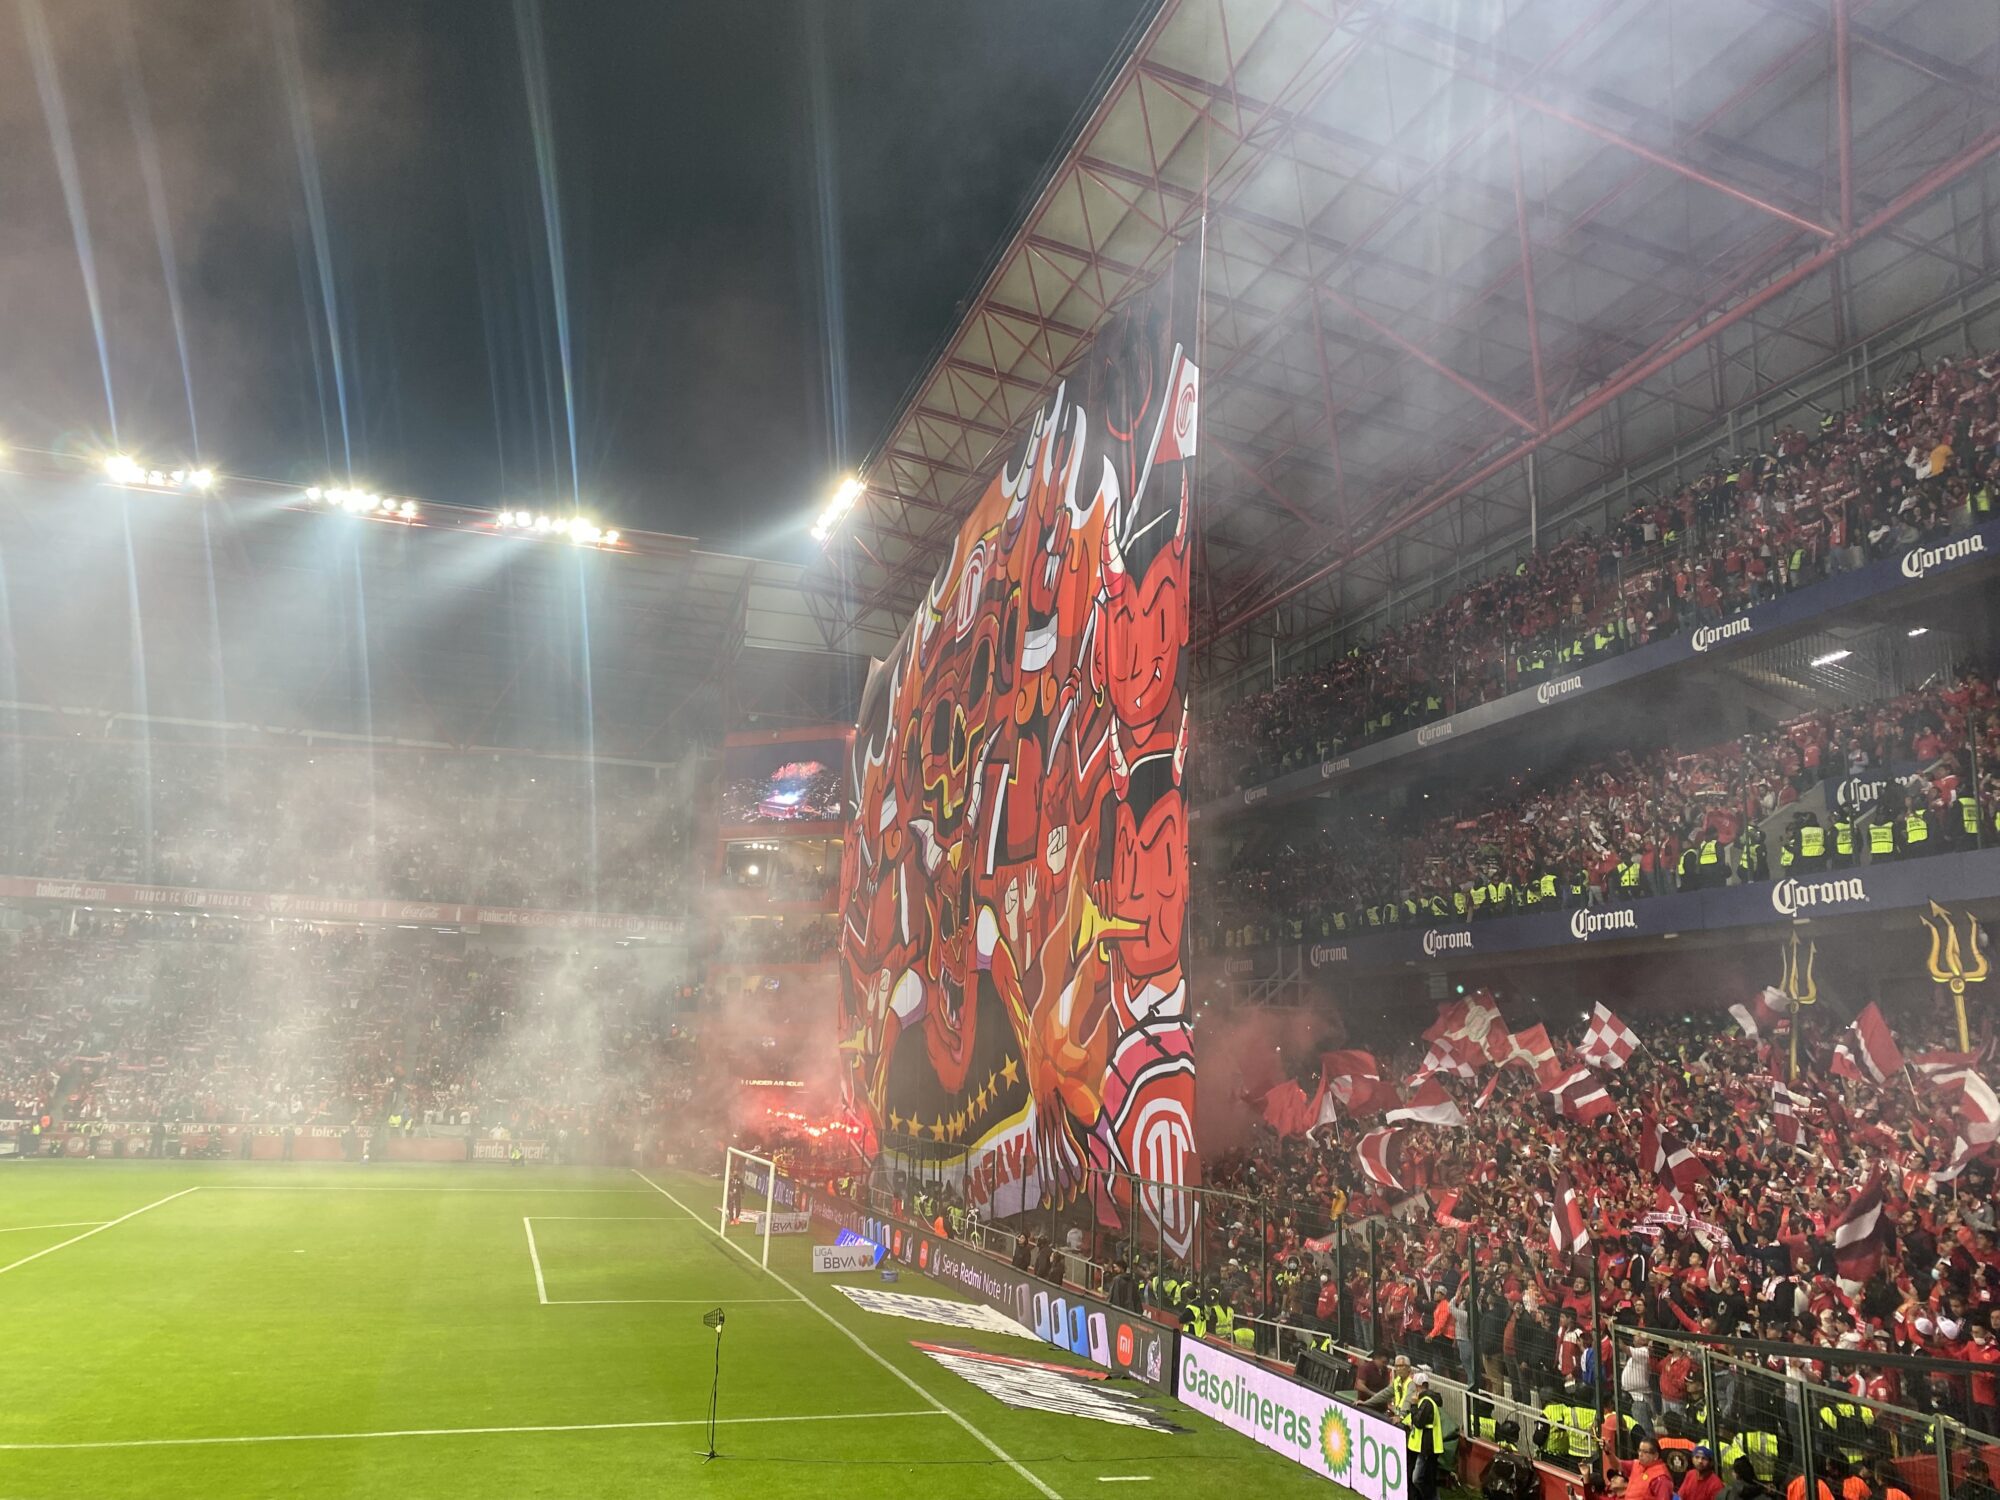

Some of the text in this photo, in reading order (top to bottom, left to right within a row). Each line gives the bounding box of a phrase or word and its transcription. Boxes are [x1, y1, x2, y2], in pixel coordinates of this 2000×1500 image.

[1902, 534, 1984, 578] Corona
[1692, 617, 1750, 652] Corona
[1537, 675, 1582, 704] Corona
[1417, 723, 1452, 746] Corona
[1322, 757, 1350, 778] Corona
[1772, 878, 1867, 917] Corona
[1570, 908, 1636, 941] Corona
[1310, 944, 1348, 969] Corona
[1423, 929, 1473, 957] Corona
[814, 1248, 833, 1257] LIGA
[823, 1257, 856, 1270] BBVA
[942, 1254, 1013, 1305] Serie Redmi Note 11
[1183, 1353, 1402, 1498] Gasolineras bp
